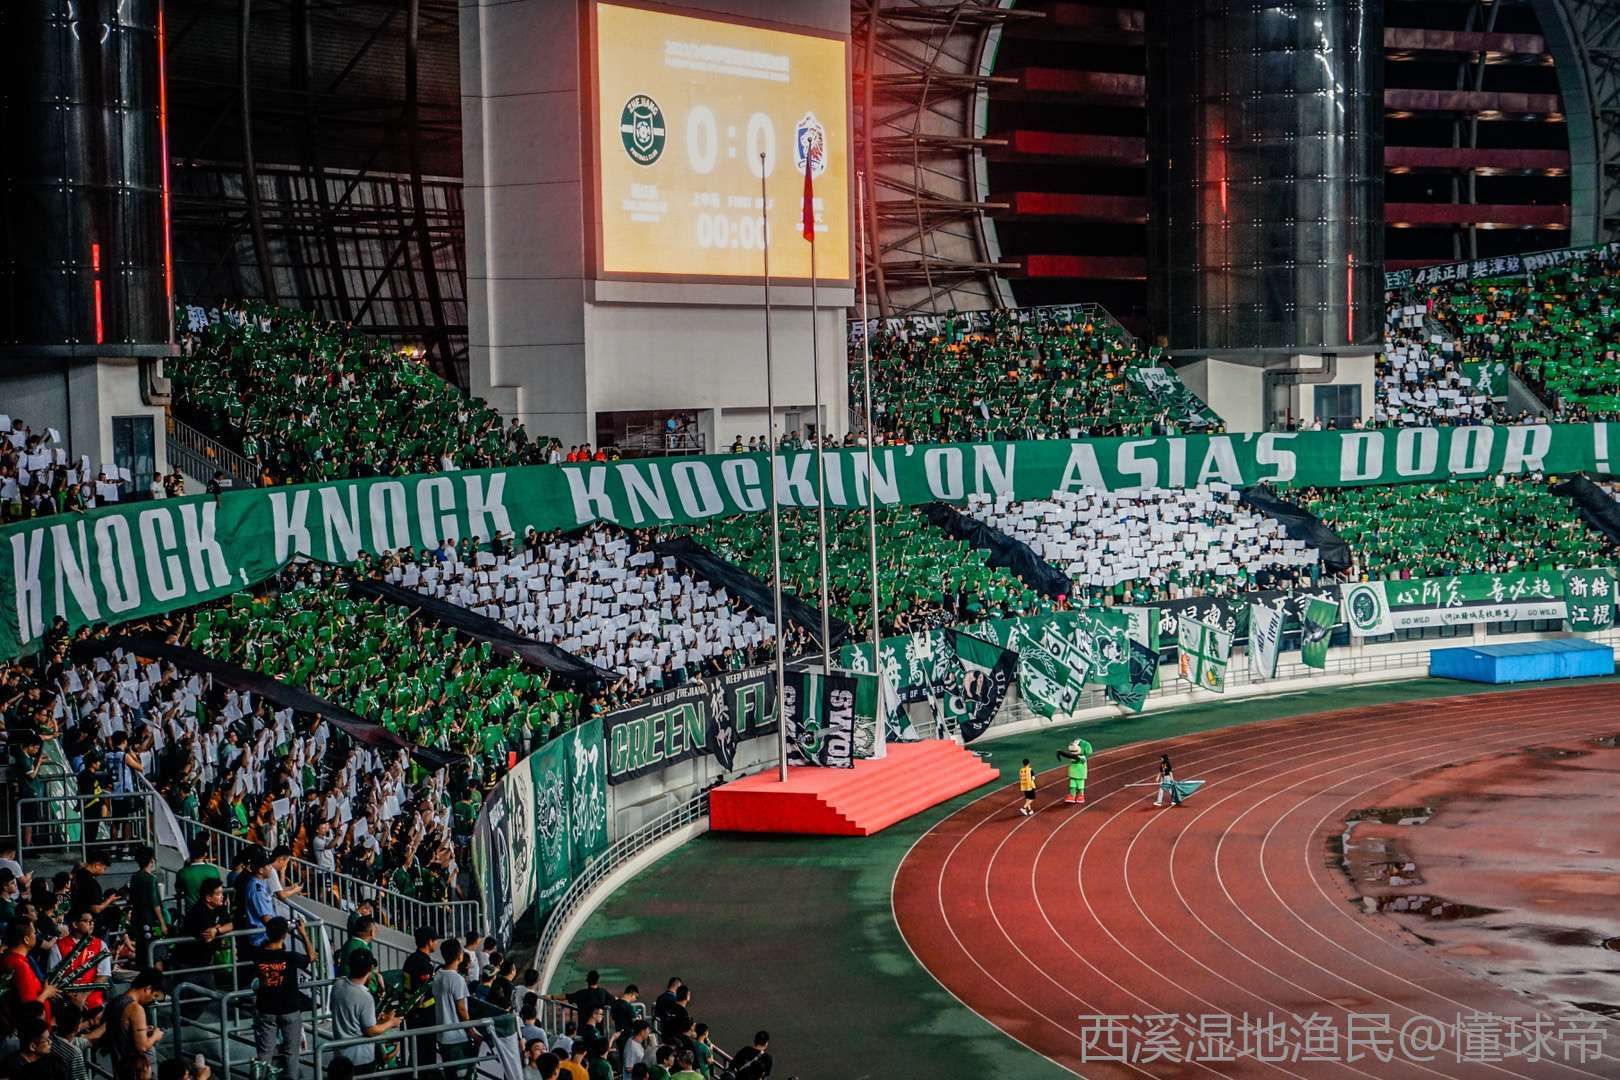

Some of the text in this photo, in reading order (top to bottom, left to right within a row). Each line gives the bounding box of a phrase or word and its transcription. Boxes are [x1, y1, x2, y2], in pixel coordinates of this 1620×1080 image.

[697, 213, 771, 249] 00:00
[1059, 432, 1298, 494] ASIA'S
[1340, 423, 1553, 482] DOOR
[1401, 616, 1430, 625] GO WILD
[1540, 608, 1557, 616] WILD
[664, 692, 676, 704] FOR
[610, 701, 707, 777] GREEN
